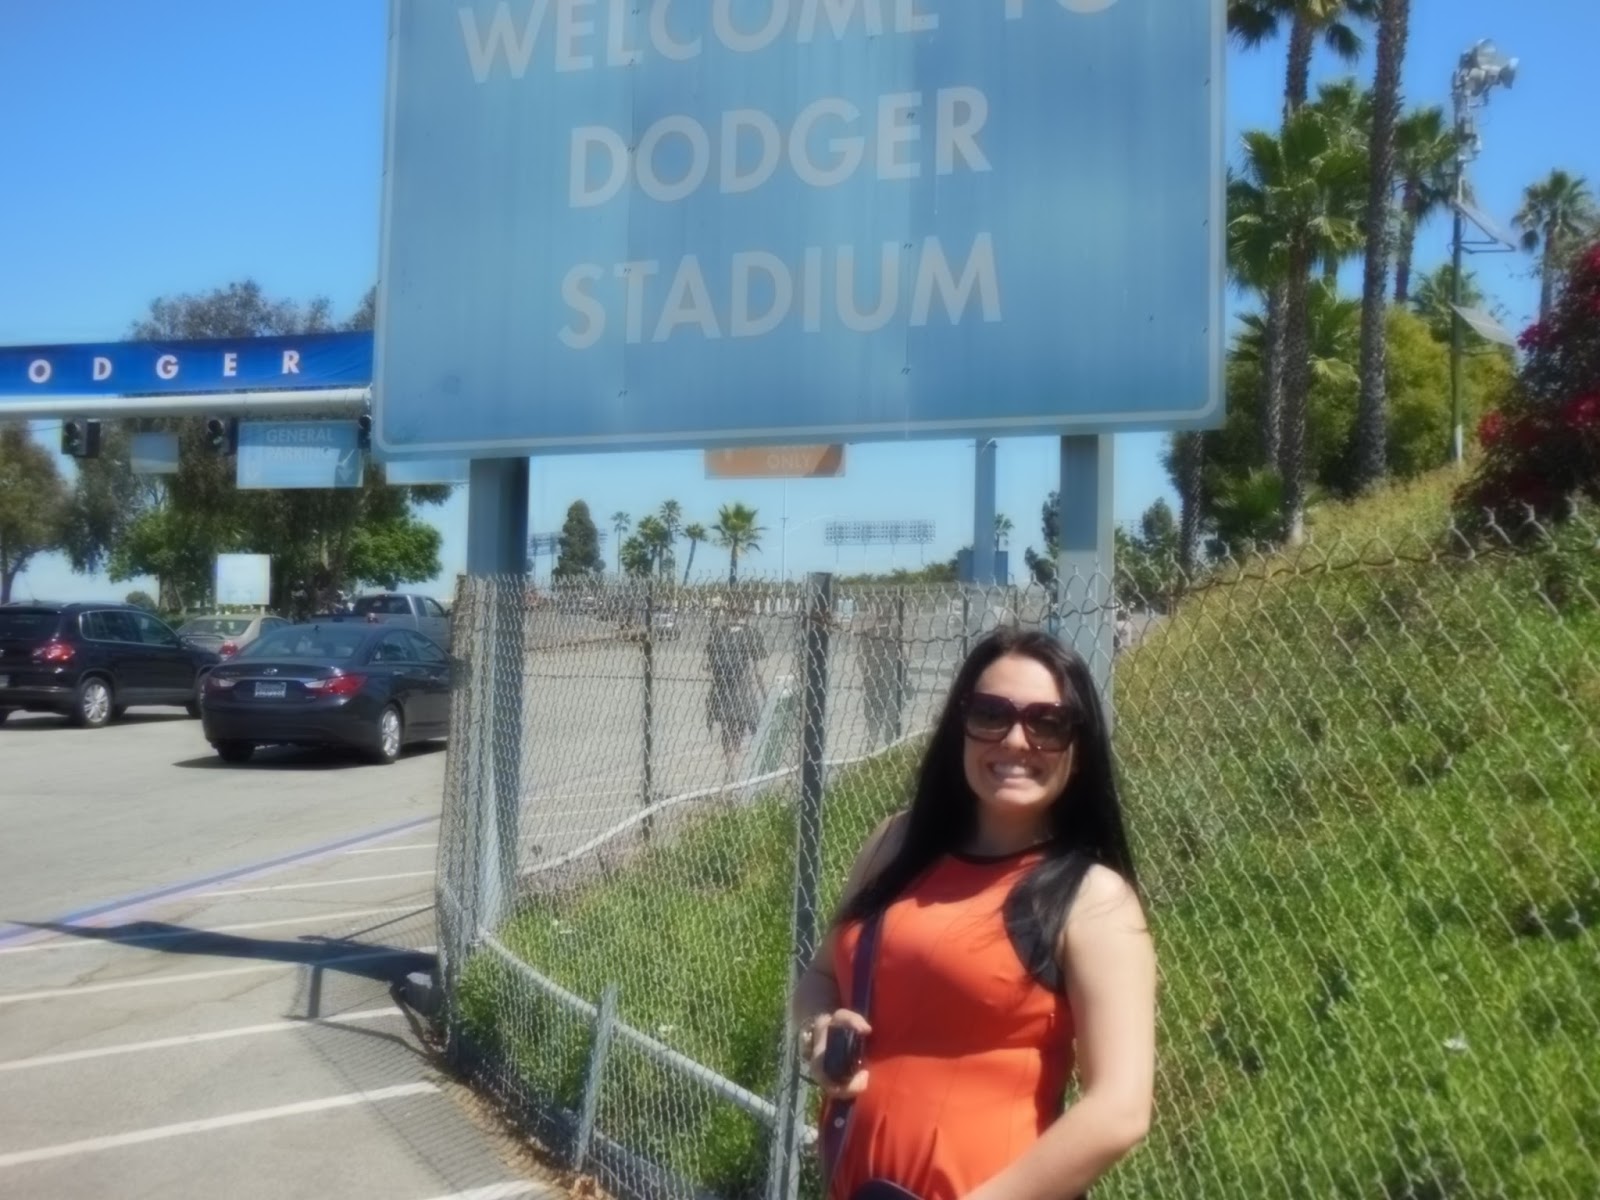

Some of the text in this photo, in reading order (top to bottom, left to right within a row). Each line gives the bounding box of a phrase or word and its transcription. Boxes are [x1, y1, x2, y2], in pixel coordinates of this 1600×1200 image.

[568, 86, 992, 208] DODGER
[558, 232, 1002, 350] STADIUM
[266, 427, 334, 443] GENERAL
[766, 453, 811, 470] ONLY
